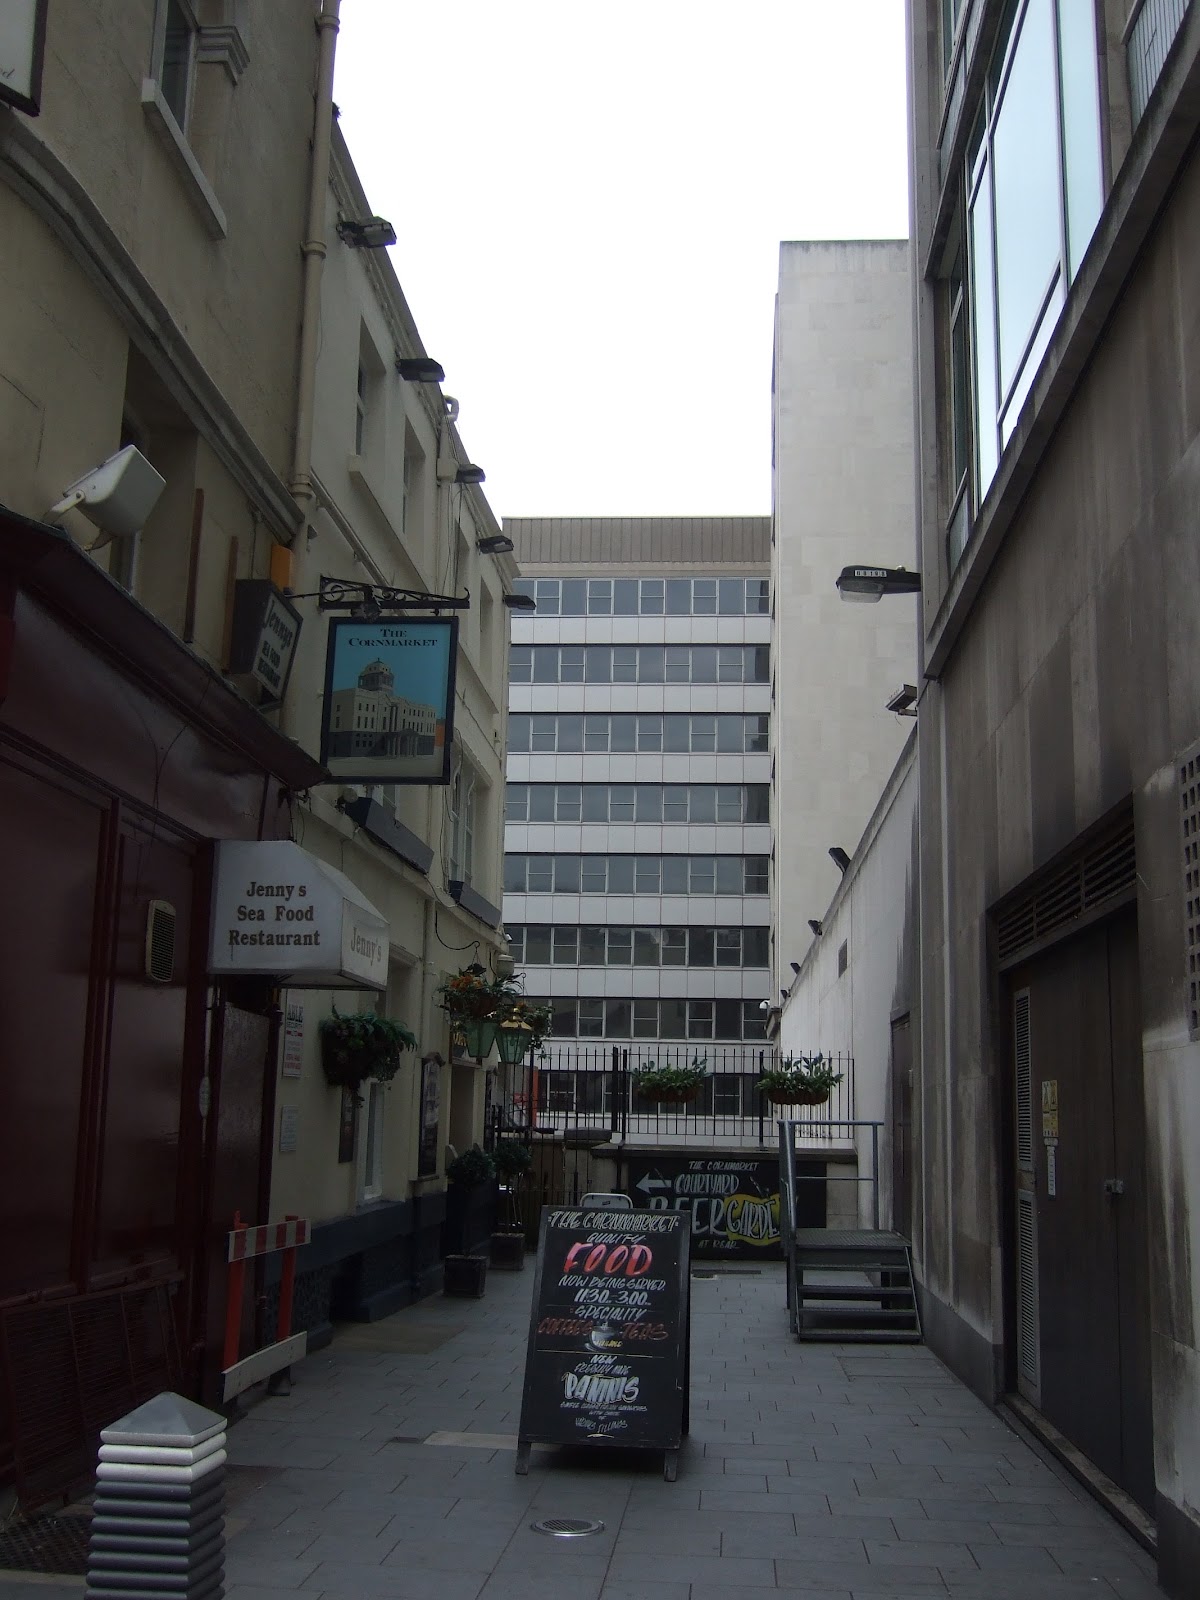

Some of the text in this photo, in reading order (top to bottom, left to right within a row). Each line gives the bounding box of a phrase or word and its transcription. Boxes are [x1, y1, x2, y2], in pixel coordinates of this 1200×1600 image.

[237, 905, 314, 922] Sea Food
[228, 930, 321, 946] Restaurant
[688, 1161, 760, 1172] THE CORNMARKET
[674, 1173, 740, 1195] COURTYARD
[551, 1210, 680, 1232] THE CORNMARKET
[726, 1199, 781, 1240] GARDE
[586, 1232, 646, 1244] QUALITY
[563, 1241, 653, 1277] FOOD
[558, 1274, 589, 1287] NOW
[588, 1276, 626, 1289] BEING
[575, 1305, 647, 1322] SPECIALITY
[590, 1354, 618, 1364] NEW
[561, 1371, 640, 1404] PANINIS
